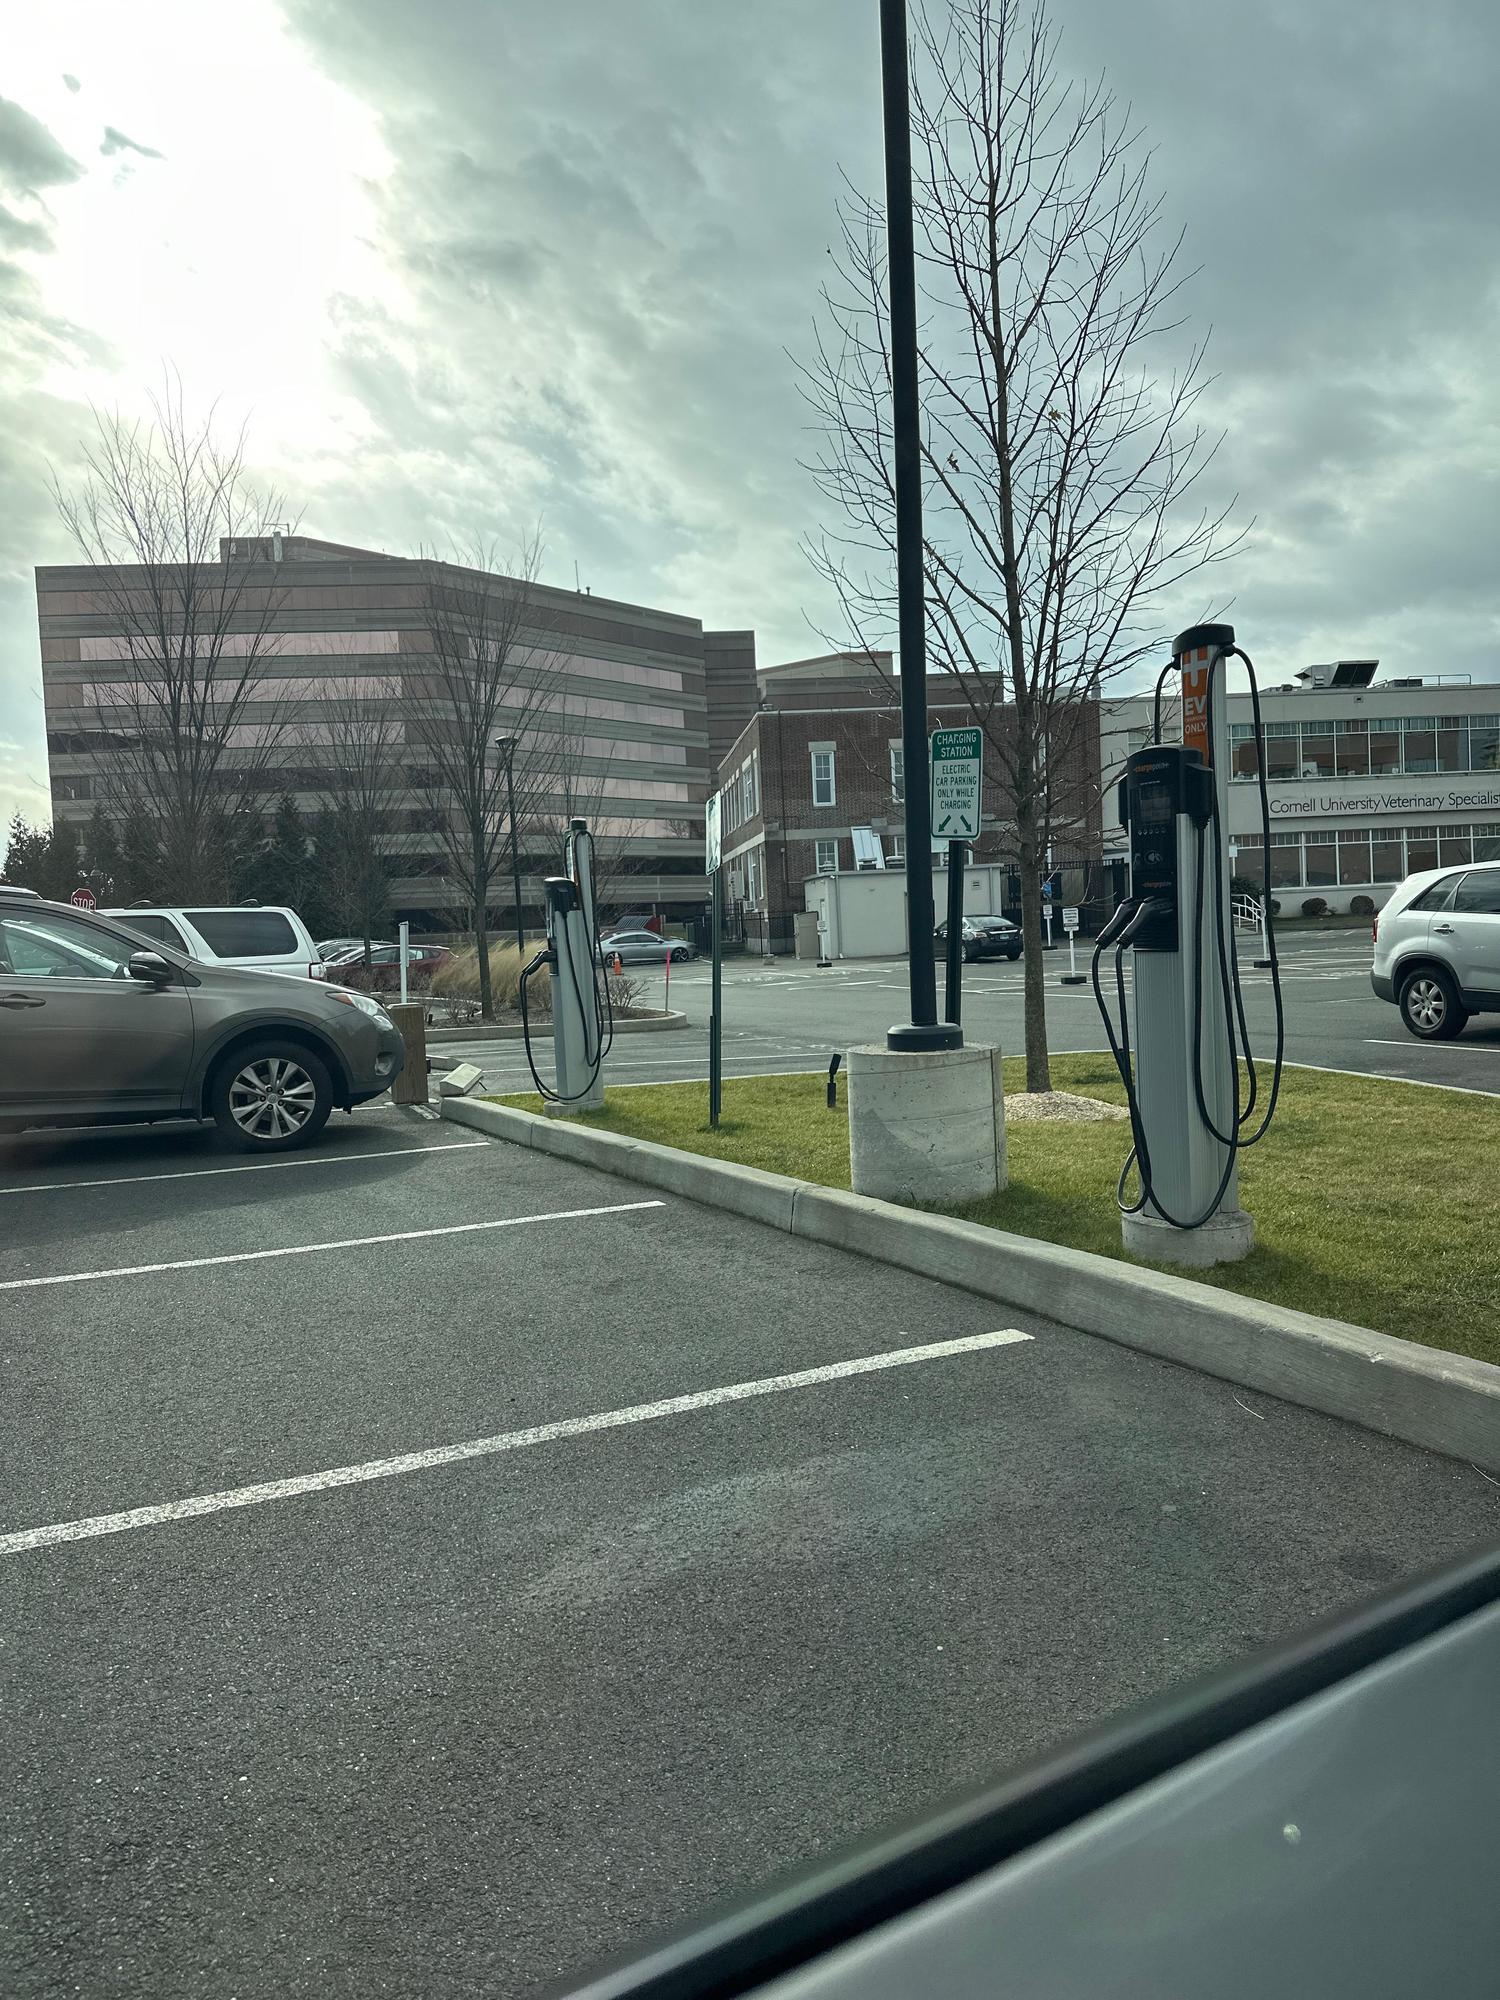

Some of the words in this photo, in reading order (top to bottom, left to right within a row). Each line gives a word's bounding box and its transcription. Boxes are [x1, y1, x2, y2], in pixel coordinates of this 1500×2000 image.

[1184, 695, 1207, 716] EV
[1185, 722, 1207, 734] ONLY
[937, 732, 976, 745] CHARGING
[941, 746, 972, 757] STATION
[942, 764, 970, 774] ELECTRIC
[936, 777, 948, 786] CAR
[950, 776, 976, 785] PARKING
[937, 789, 954, 798] ONLY
[956, 788, 974, 797] WHILE
[941, 800, 971, 809] CHARGING
[1269, 797, 1317, 814] Cornell
[1319, 796, 1381, 812] University
[1380, 793, 1445, 810] Veterinary
[73, 897, 94, 910] STOP
